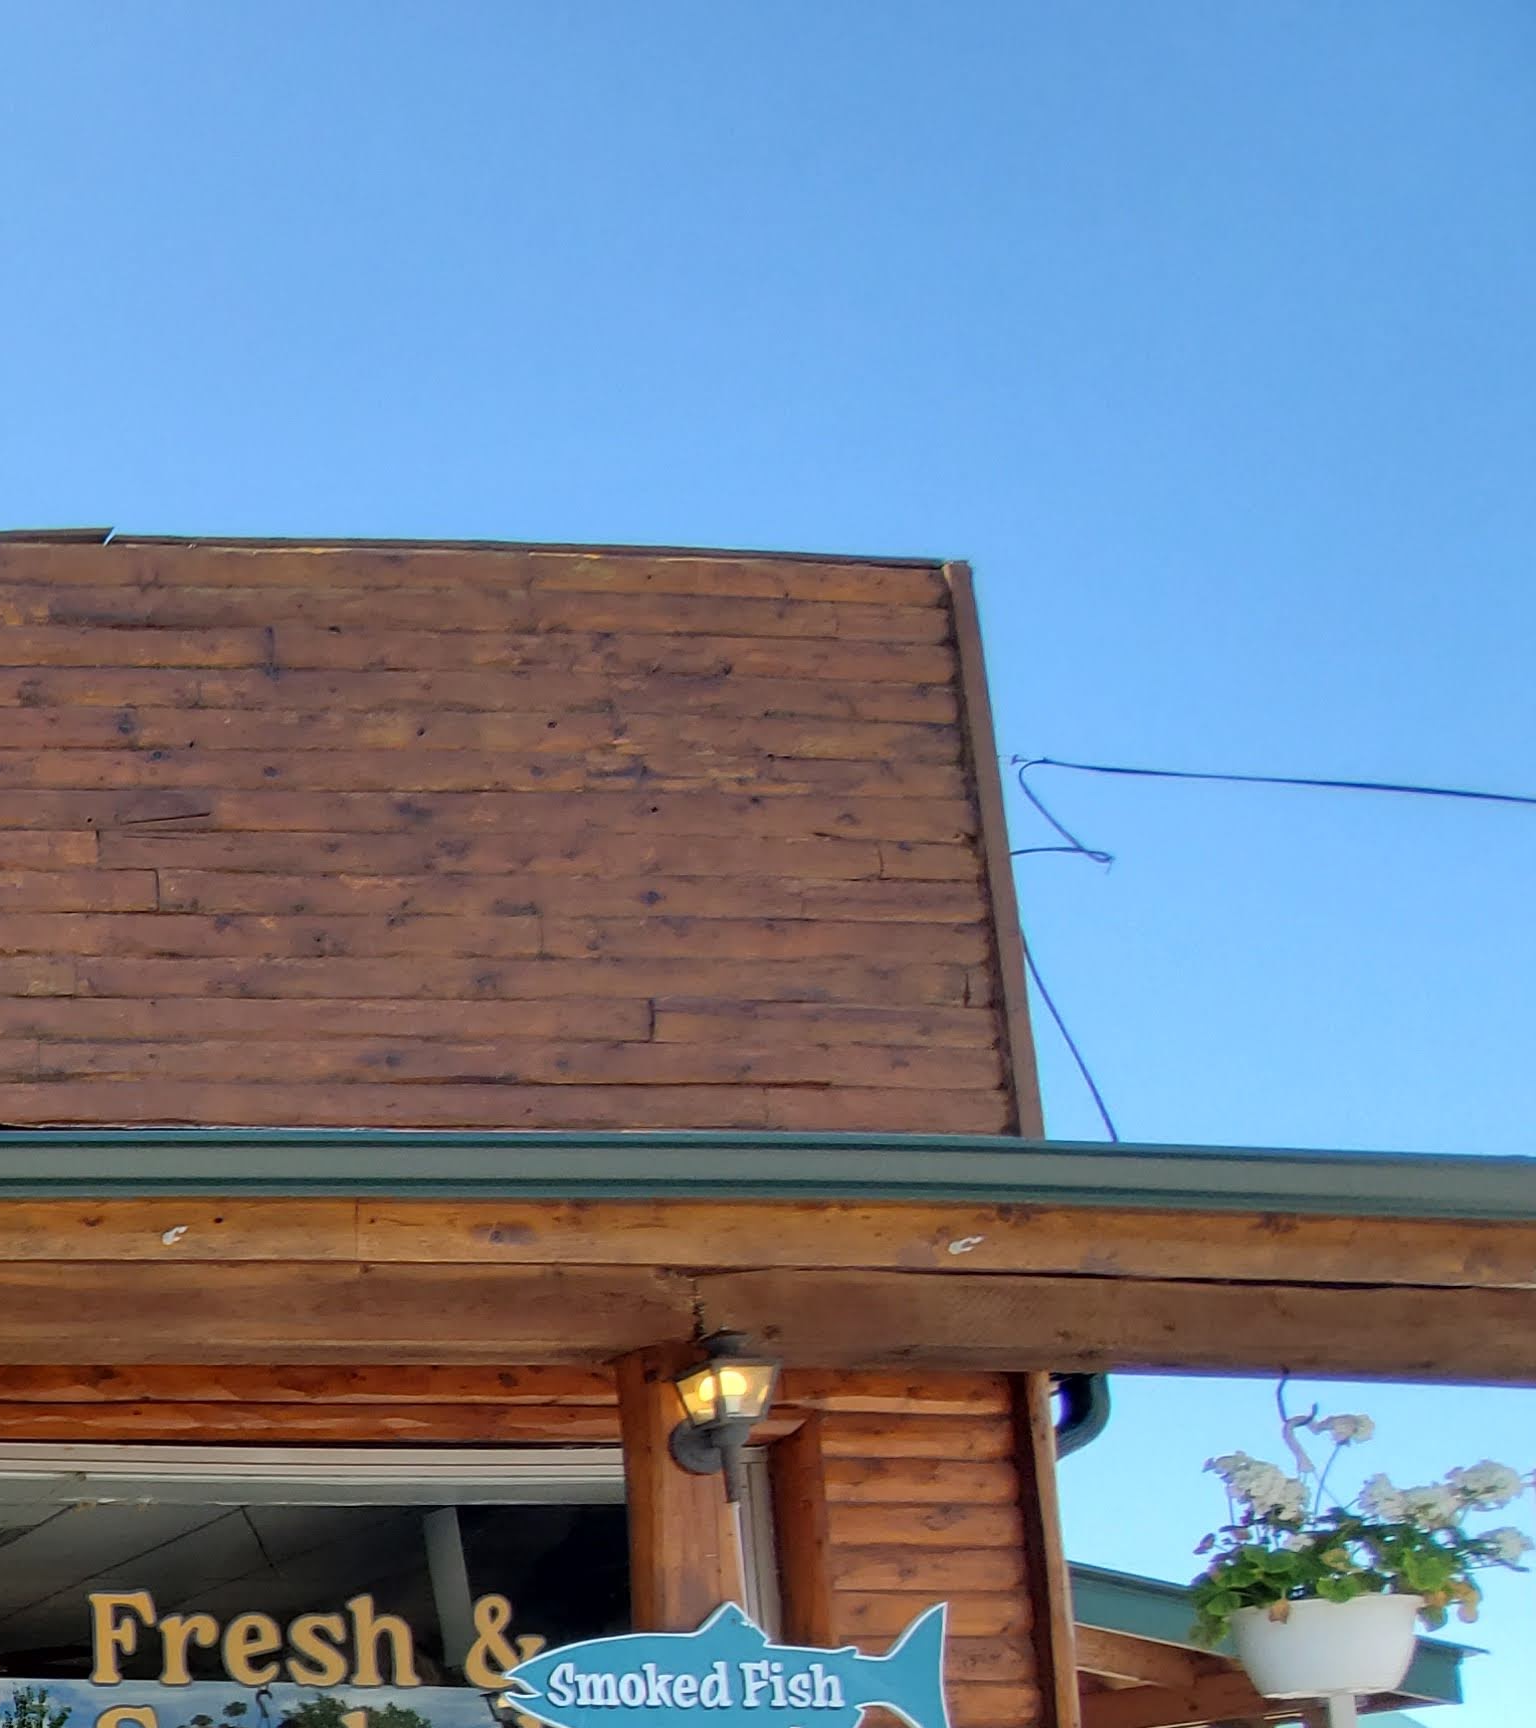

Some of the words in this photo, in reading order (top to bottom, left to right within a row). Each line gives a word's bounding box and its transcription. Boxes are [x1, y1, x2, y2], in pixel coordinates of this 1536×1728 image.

[86, 1589, 422, 1689] Fresh
[464, 1593, 547, 1689] &
[547, 1661, 728, 1709] Smoked
[740, 1659, 846, 1709] Fish
